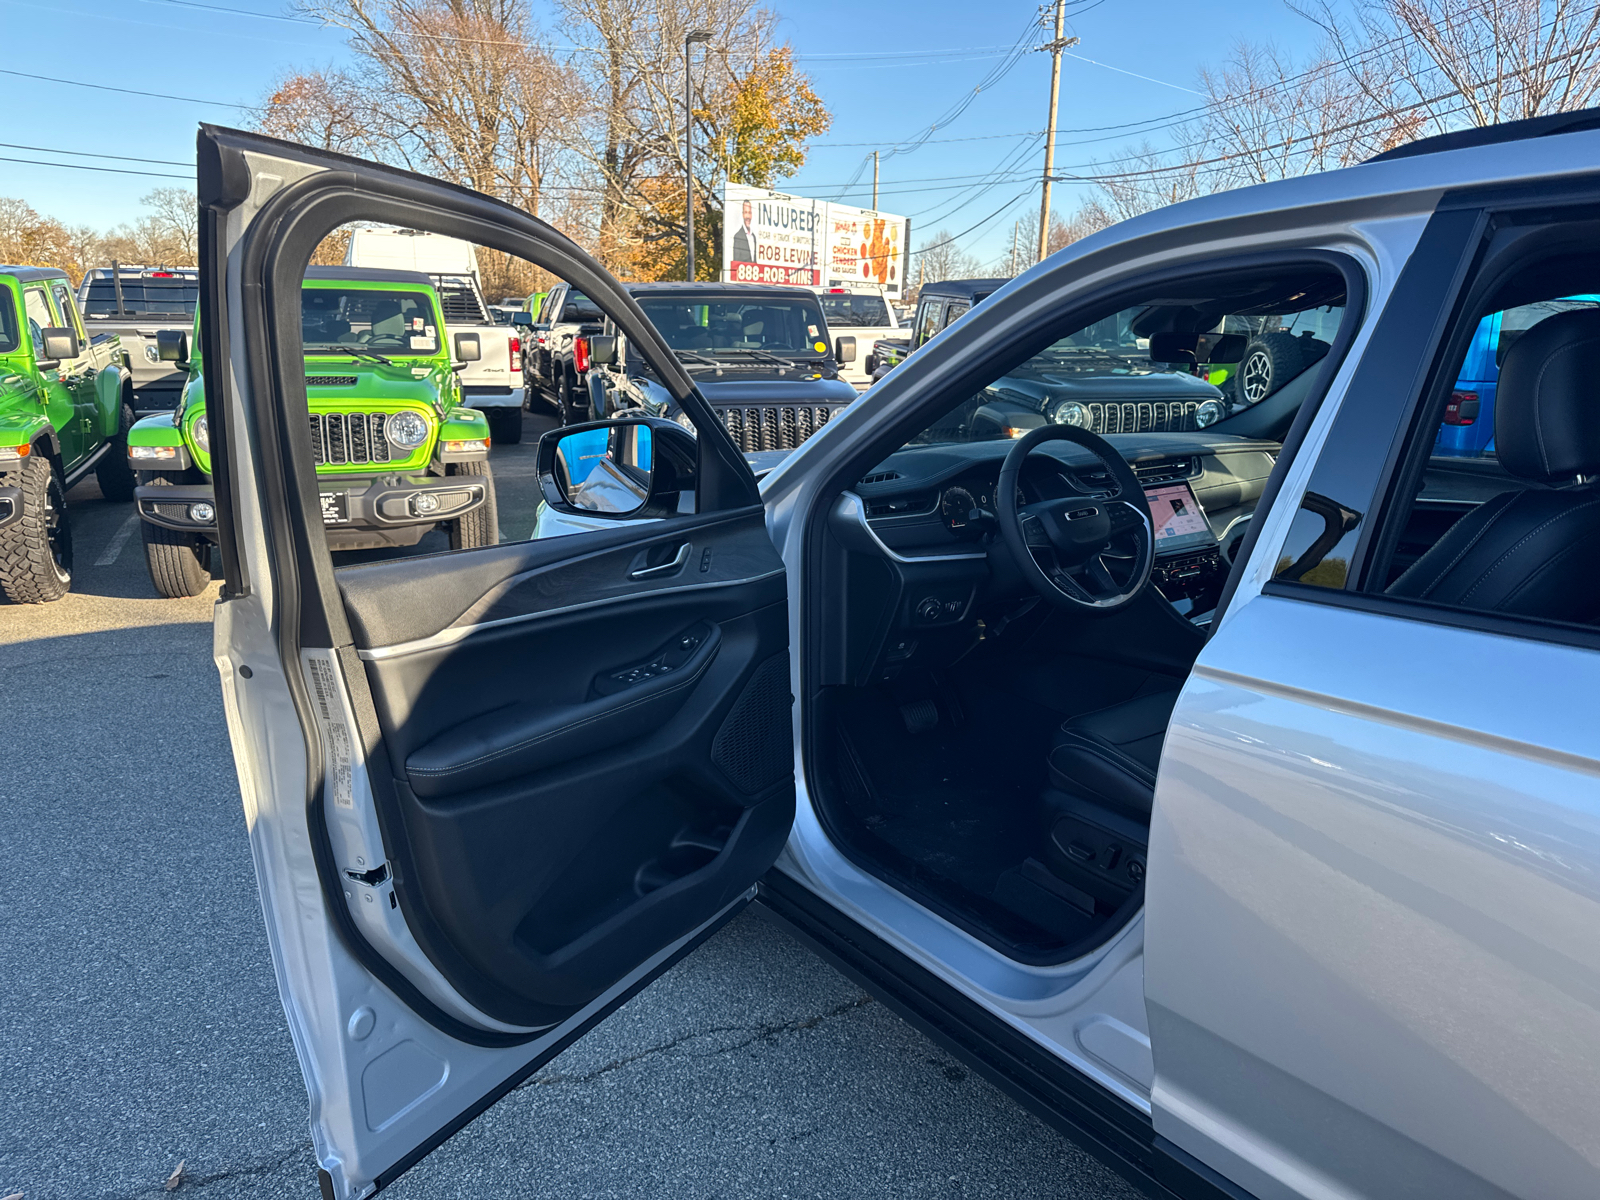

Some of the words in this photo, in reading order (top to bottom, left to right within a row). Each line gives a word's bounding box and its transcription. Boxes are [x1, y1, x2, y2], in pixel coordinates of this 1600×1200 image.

[758, 202, 820, 233] INJURED?
[758, 244, 781, 261] ROB
[783, 247, 819, 266] LEVINE
[832, 245, 858, 256] CHICKEN
[832, 256, 857, 267] TENDERS
[738, 264, 814, 285] 888-ROB-WINS
